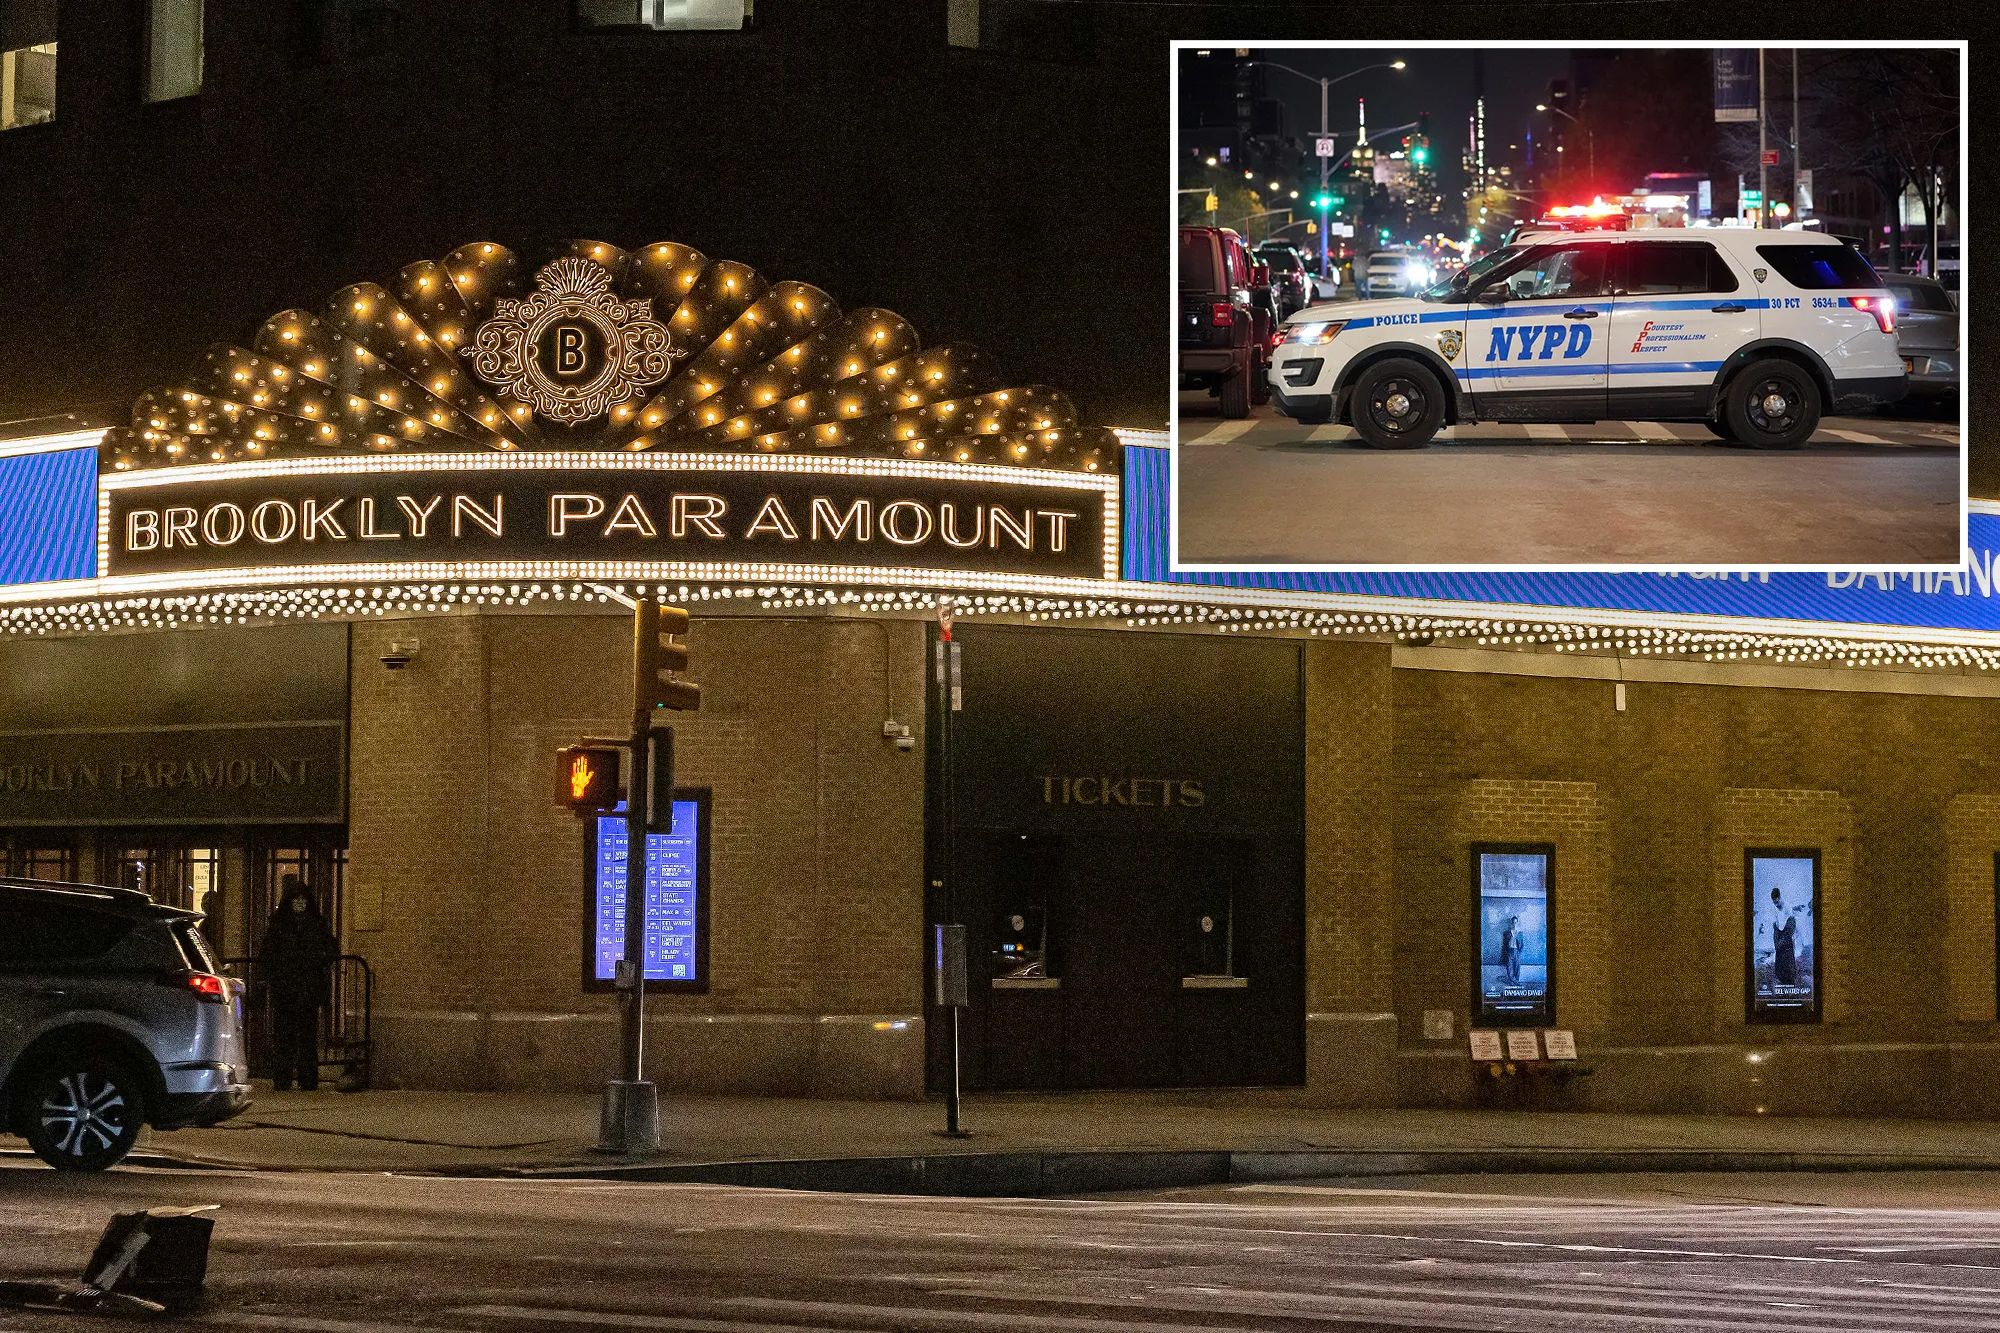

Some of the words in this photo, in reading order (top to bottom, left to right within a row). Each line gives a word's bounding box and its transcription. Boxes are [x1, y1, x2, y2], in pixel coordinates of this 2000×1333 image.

[1771, 298, 1782, 309] 30
[1784, 298, 1800, 309] PCT
[1811, 297, 1832, 308] 3634
[1376, 314, 1418, 327] POLICE
[1643, 321, 1684, 331] COURTESY
[1485, 323, 1593, 362] NYPD
[1637, 331, 1707, 342] PROFESSIONALISM
[557, 328, 586, 374] B
[1631, 342, 1668, 353] RESPECT
[126, 493, 503, 553] BROOKLYN
[548, 493, 1079, 553] PARAMOUNT
[0, 761, 98, 791] OKLYN
[112, 757, 311, 789] PARAMOUNT
[1037, 776, 1206, 807] TICKETS
